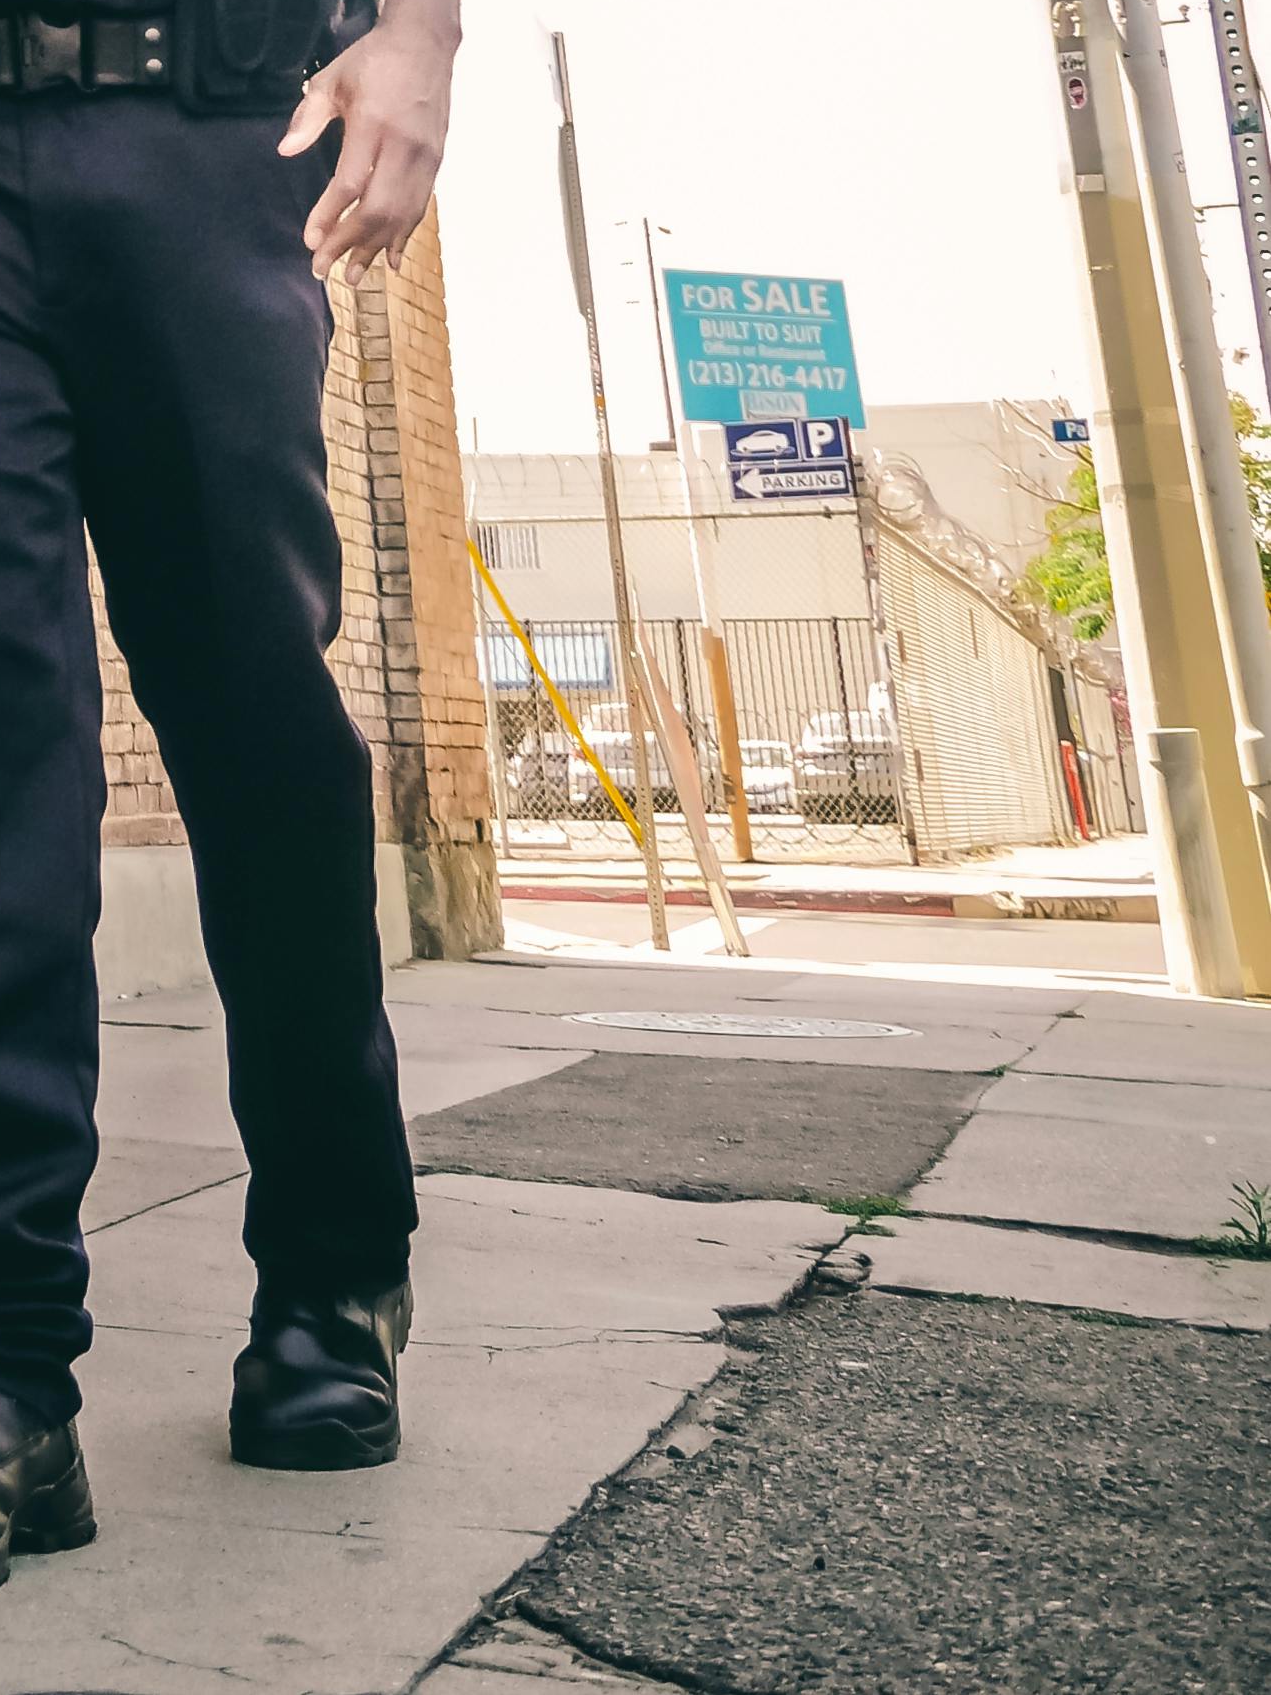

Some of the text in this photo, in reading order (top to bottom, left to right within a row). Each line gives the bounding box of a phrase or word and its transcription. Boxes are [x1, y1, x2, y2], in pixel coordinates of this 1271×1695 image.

[681, 280, 832, 317] FOR SALE
[699, 318, 822, 344] BUILT TO SUIT
[689, 359, 847, 390] (213) 216-4417
[807, 422, 835, 458] P
[760, 470, 842, 491] PARKING
